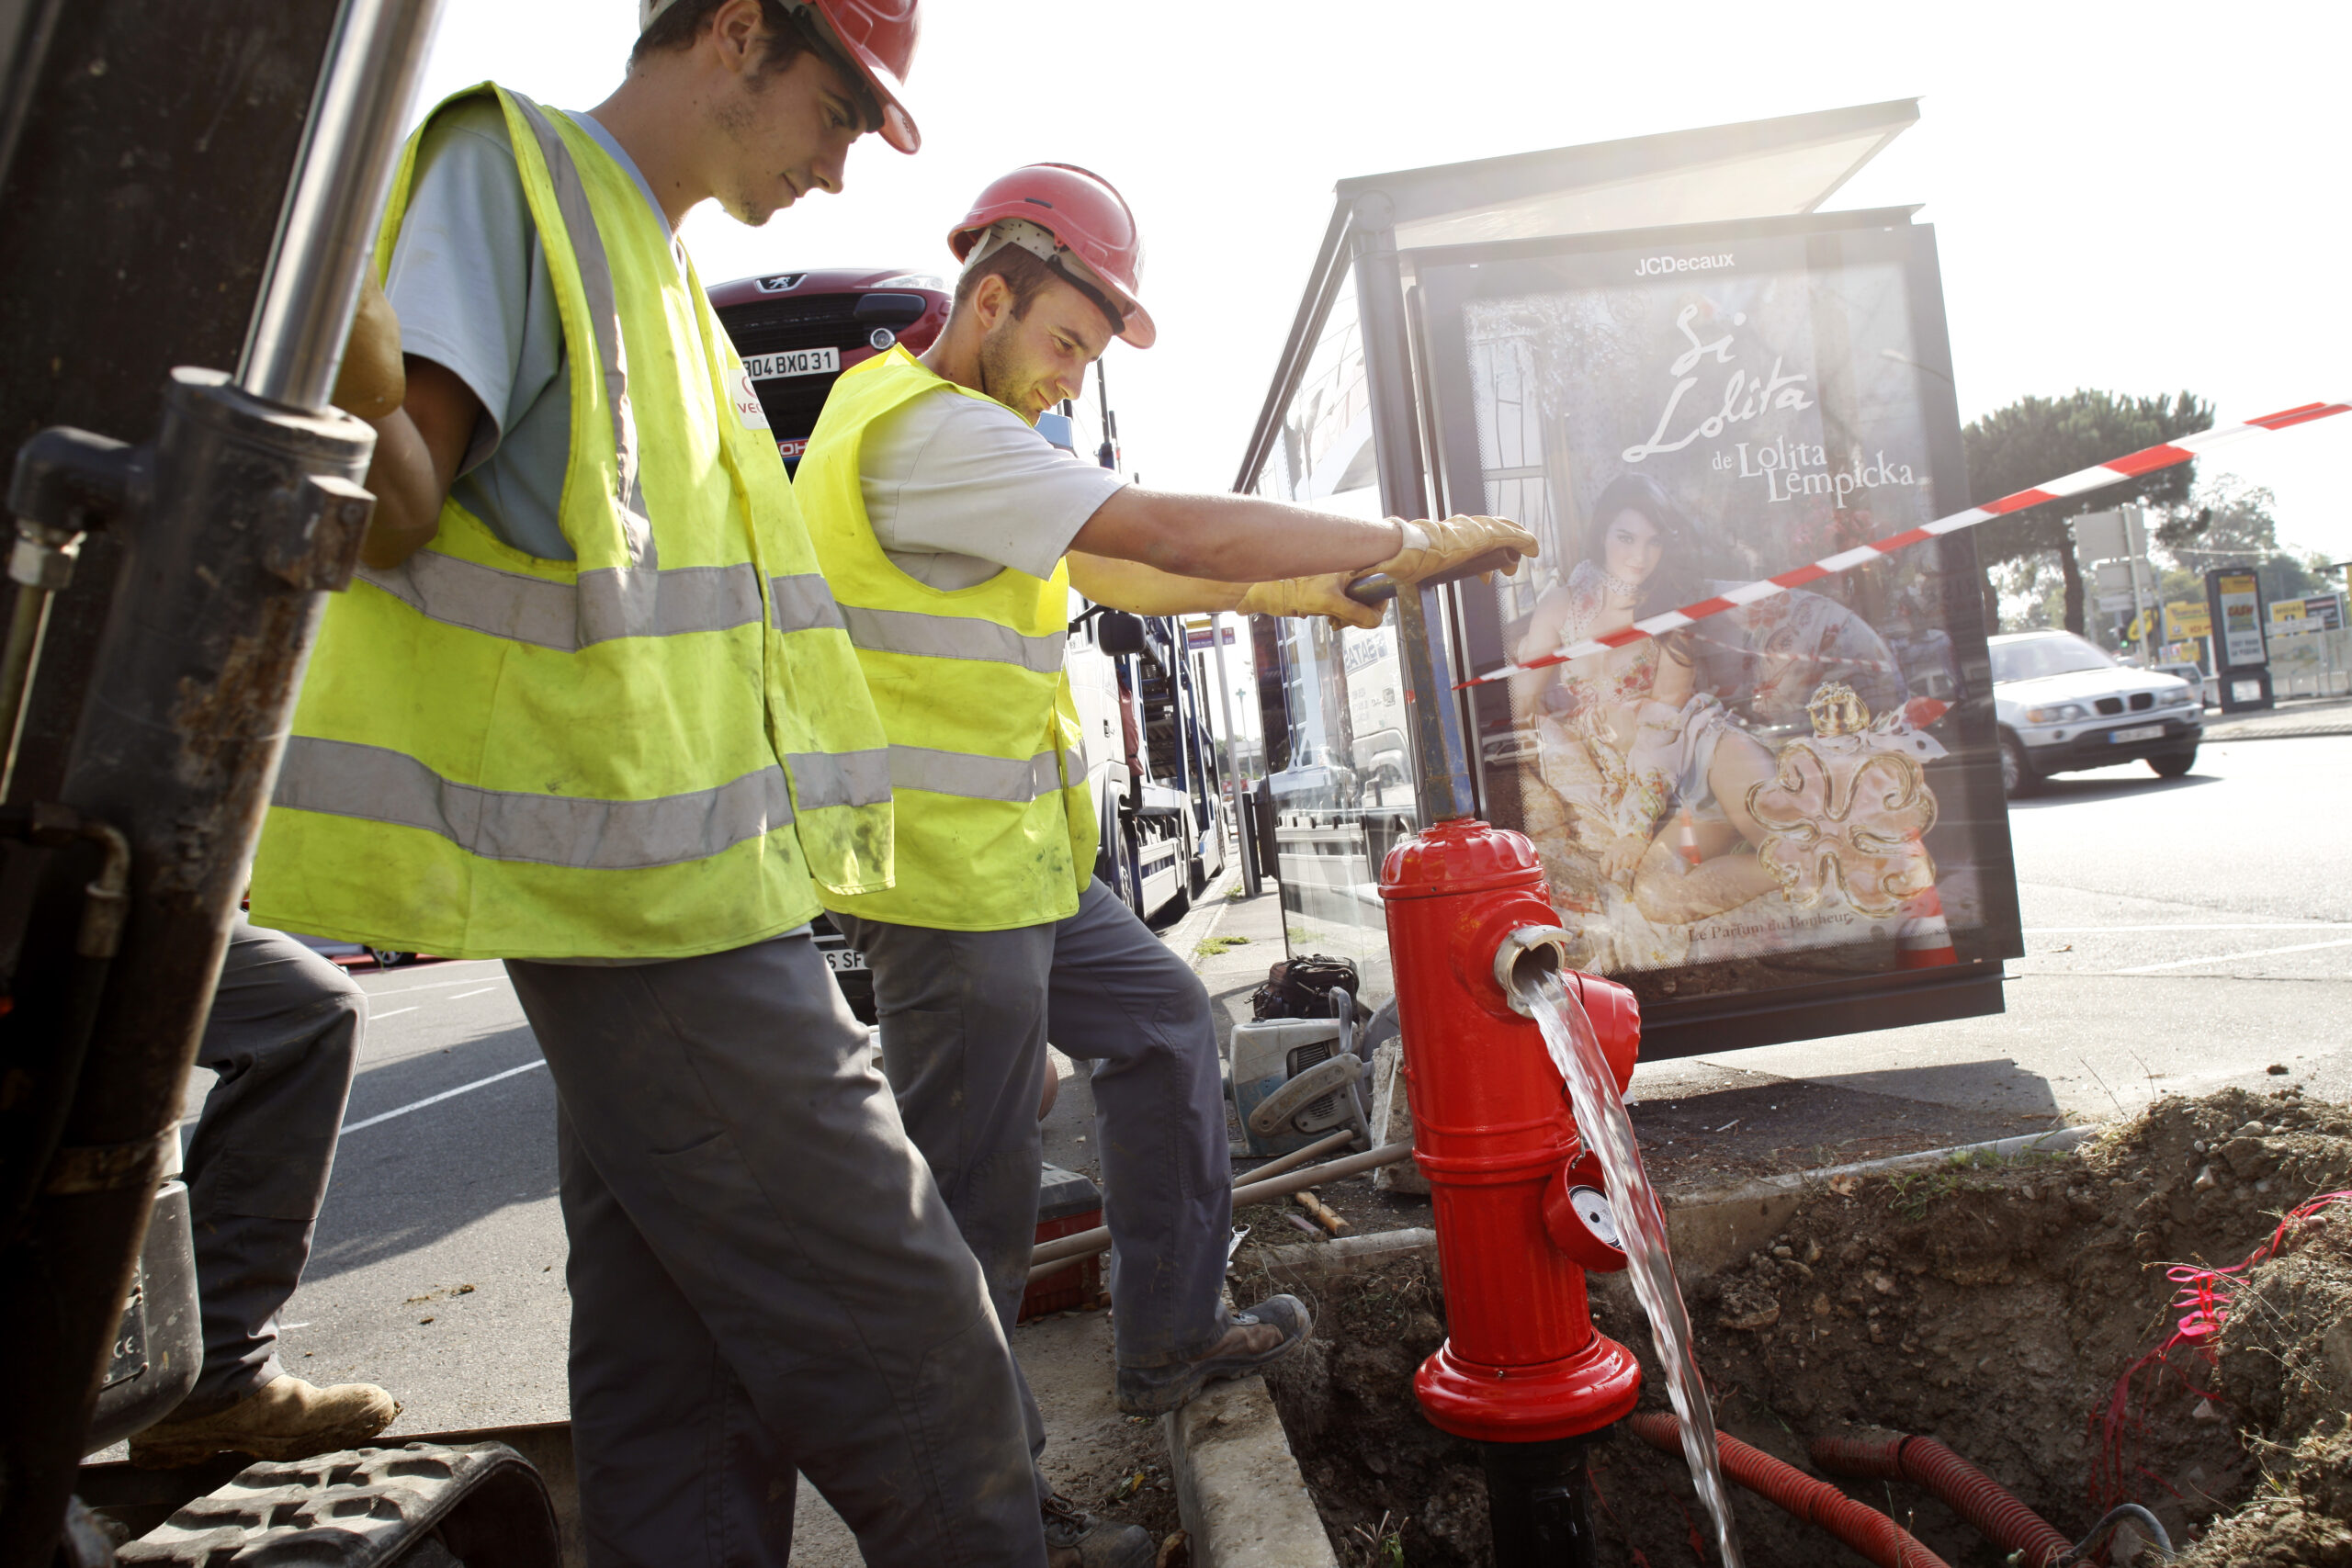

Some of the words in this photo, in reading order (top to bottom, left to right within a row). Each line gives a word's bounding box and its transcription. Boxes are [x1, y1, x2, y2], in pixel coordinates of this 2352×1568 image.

[1635, 254, 1735, 276] JCDecaux
[1669, 304, 1747, 378] Si
[1622, 355, 1815, 463] Lolita
[1712, 450, 1734, 471] de
[1735, 434, 1828, 479] Lolita
[1764, 449, 1915, 509] Lempicka
[1688, 928, 1707, 942] Le
[1712, 921, 1765, 940] Parfum
[1768, 919, 1786, 931] du
[1789, 911, 1850, 929] Bonheur
